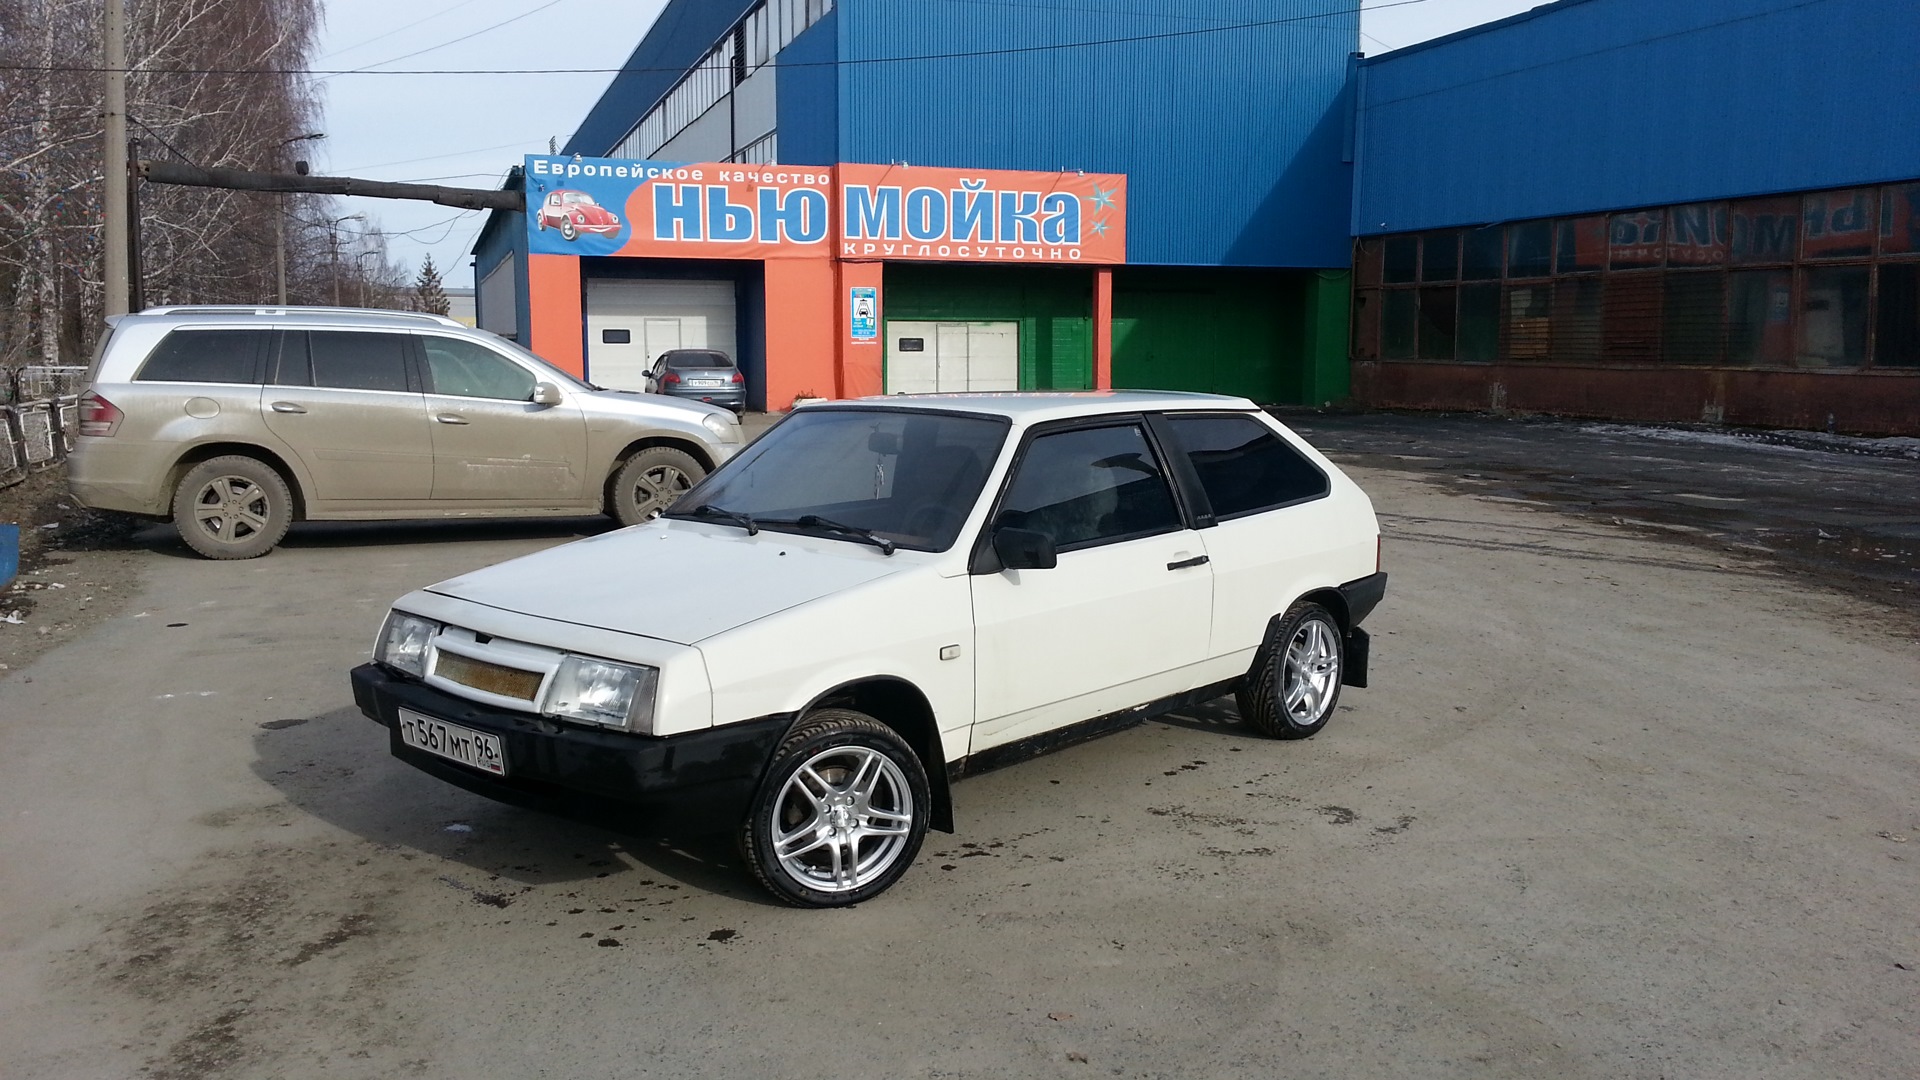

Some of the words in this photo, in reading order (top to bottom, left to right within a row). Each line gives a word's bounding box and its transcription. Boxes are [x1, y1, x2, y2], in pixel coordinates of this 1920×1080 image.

[533, 159, 703, 180] Европейское
[719, 170, 830, 185] качество
[843, 243, 1082, 260] КРУГЛОСУТОЧНО
